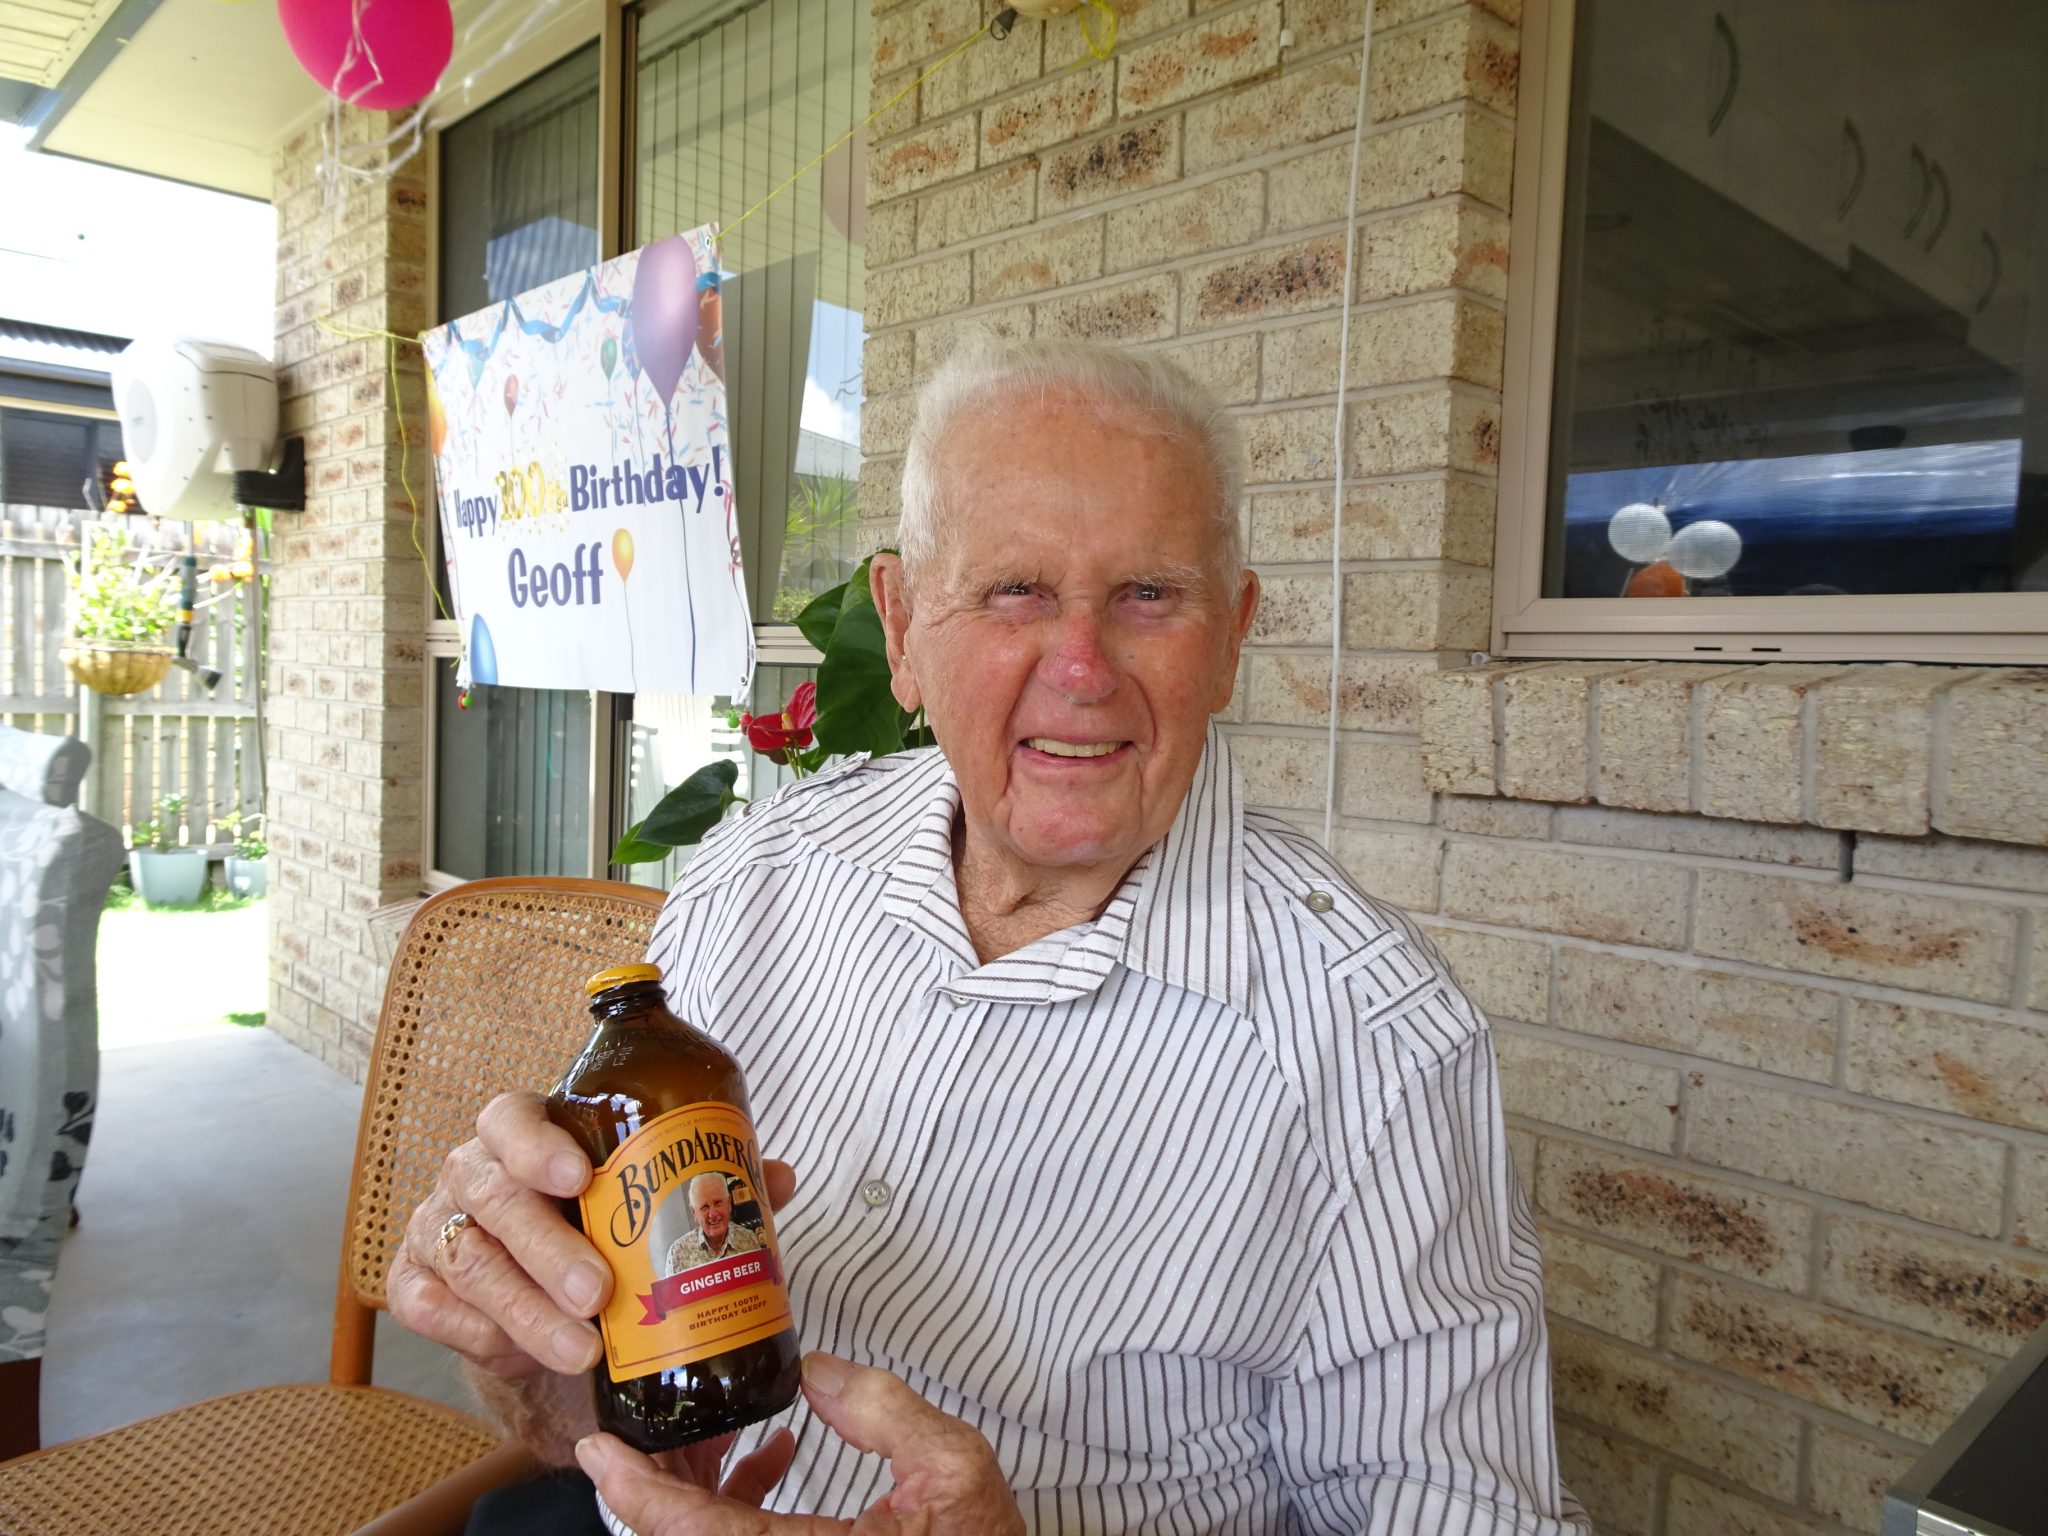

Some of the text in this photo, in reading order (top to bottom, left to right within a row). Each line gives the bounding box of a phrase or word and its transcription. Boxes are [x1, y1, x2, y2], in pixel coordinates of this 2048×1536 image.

[453, 488, 498, 539] Happy
[569, 444, 725, 514] Birthday!
[507, 541, 604, 608] Geoff
[680, 1260, 761, 1295] GINGER BEER
[688, 1311, 739, 1331] BIRTHDAY
[741, 1299, 767, 1314] GEOFF
[696, 1293, 760, 1320] HAPPY 100TH
